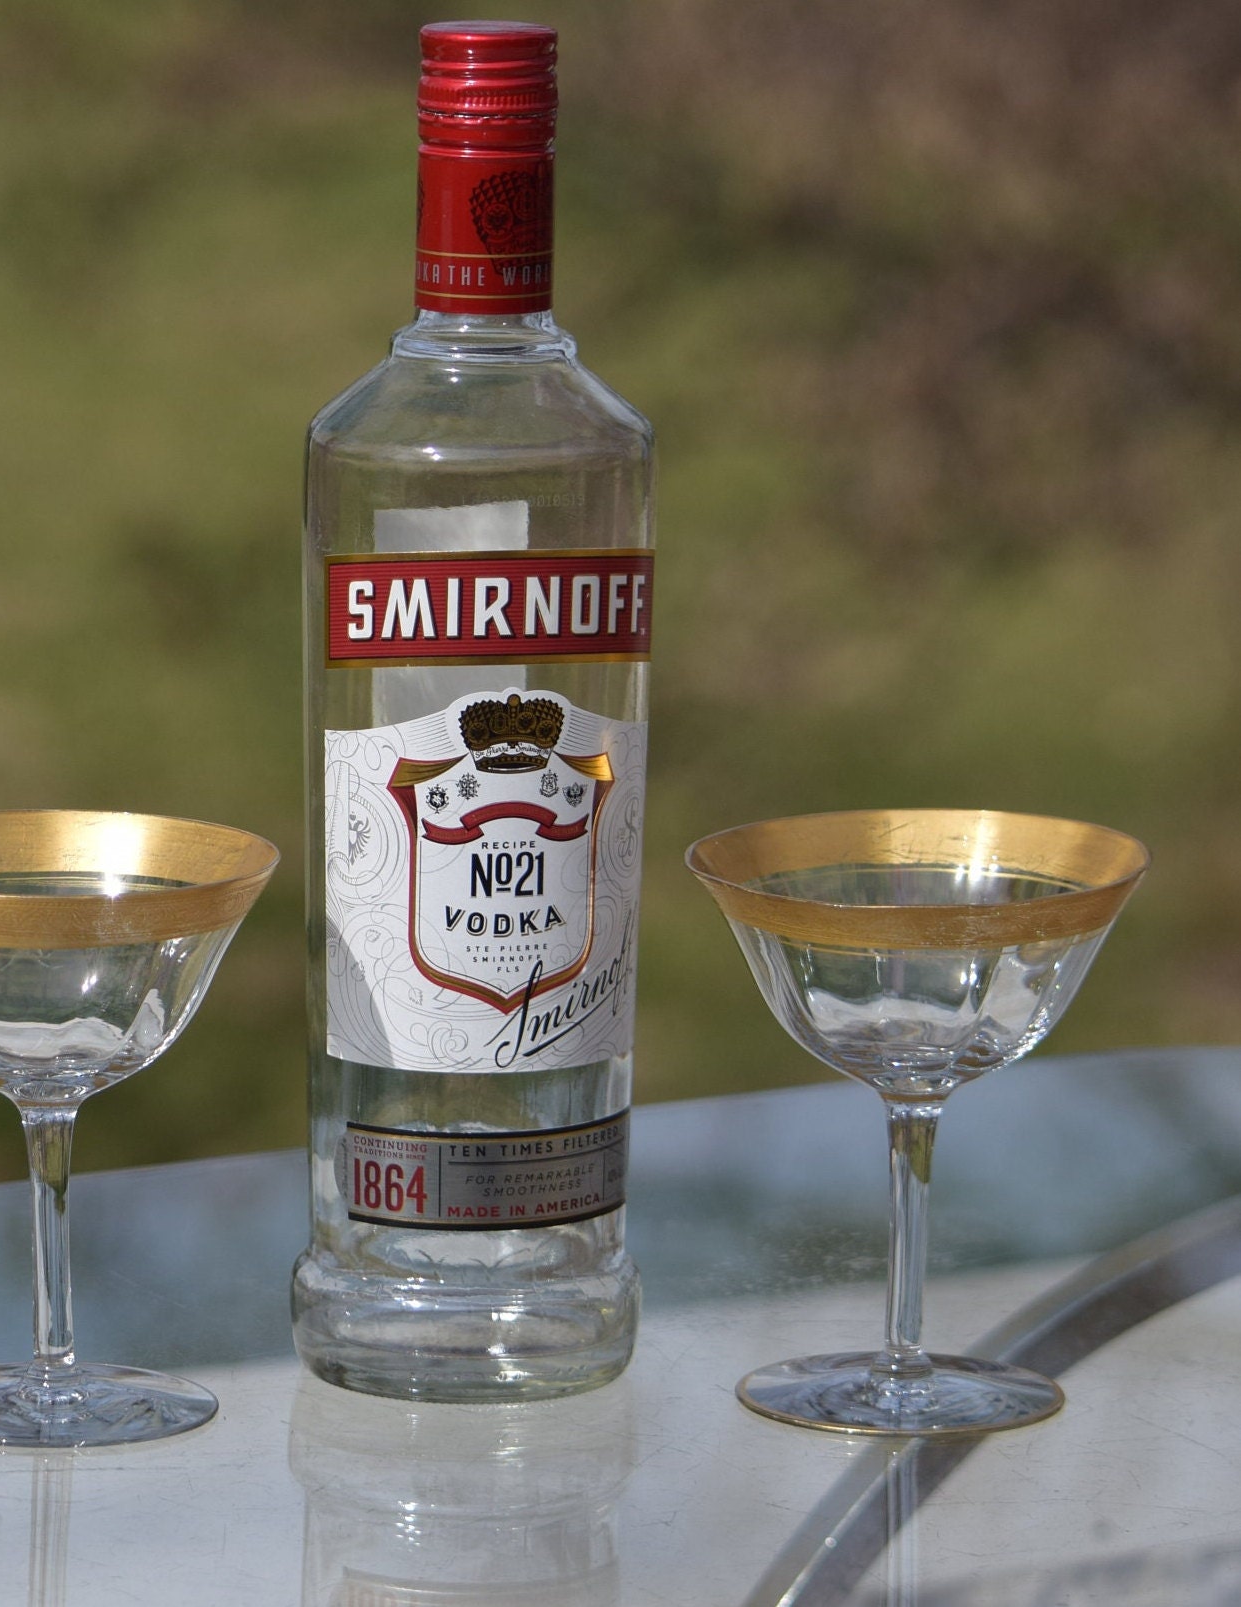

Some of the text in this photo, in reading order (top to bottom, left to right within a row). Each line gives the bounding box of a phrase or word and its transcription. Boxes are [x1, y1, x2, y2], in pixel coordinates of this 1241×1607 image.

[447, 264, 486, 287] THE
[347, 574, 645, 640] SMIRNOFF
[481, 840, 536, 850] RECIPE
[445, 904, 567, 938] VODKA
[466, 943, 548, 953] STE PIERRE
[473, 954, 542, 963] SMIRNOFF
[497, 965, 520, 973] FLS
[353, 1135, 428, 1153] CONTINUING
[450, 1125, 619, 1157] TEN TIMES FILTERED
[465, 1174, 496, 1185] FOR
[503, 1163, 595, 1184] REMARKABLE
[353, 1157, 428, 1214] 1864
[482, 1179, 582, 1198] SMOOTHNESS
[447, 1192, 600, 1218] MADE IN AMERICA
